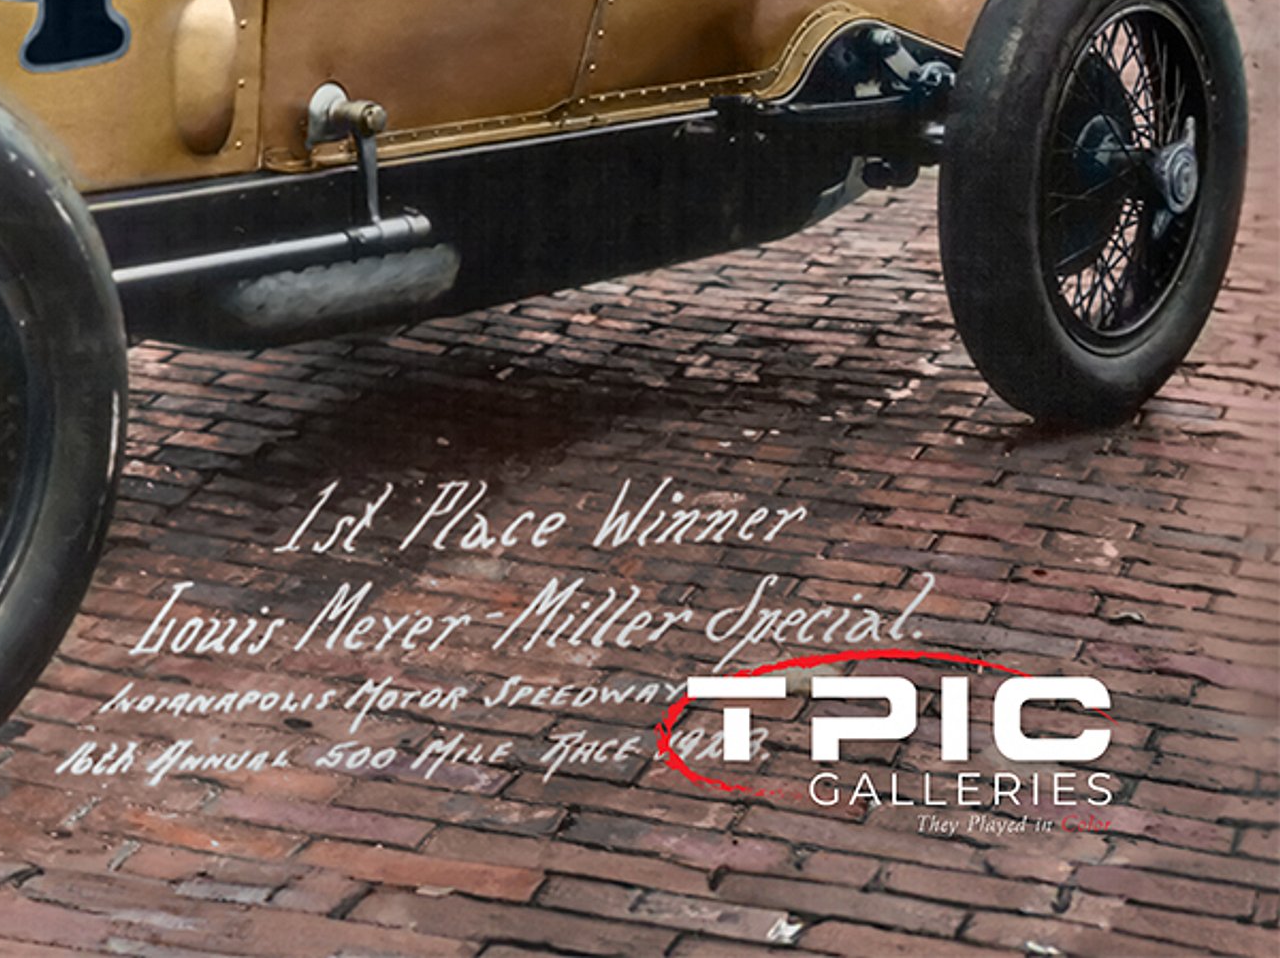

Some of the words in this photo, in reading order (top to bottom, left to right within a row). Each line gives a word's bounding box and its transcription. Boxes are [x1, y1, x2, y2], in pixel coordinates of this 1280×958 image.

[274, 481, 393, 553] 1st
[400, 481, 566, 550] Place
[593, 477, 807, 547] Winner
[128, 581, 285, 655] Louis
[706, 572, 936, 673] Special.
[99, 681, 337, 717] INDIANAPOLIS
[344, 675, 469, 735] MOTOR
[484, 675, 687, 708] SPEEDWAY
[55, 742, 138, 775] 16th
[145, 739, 289, 787] ANNUAL
[315, 741, 397, 770] 500
[410, 733, 513, 780] MILE
[540, 731, 641, 783] RACE
